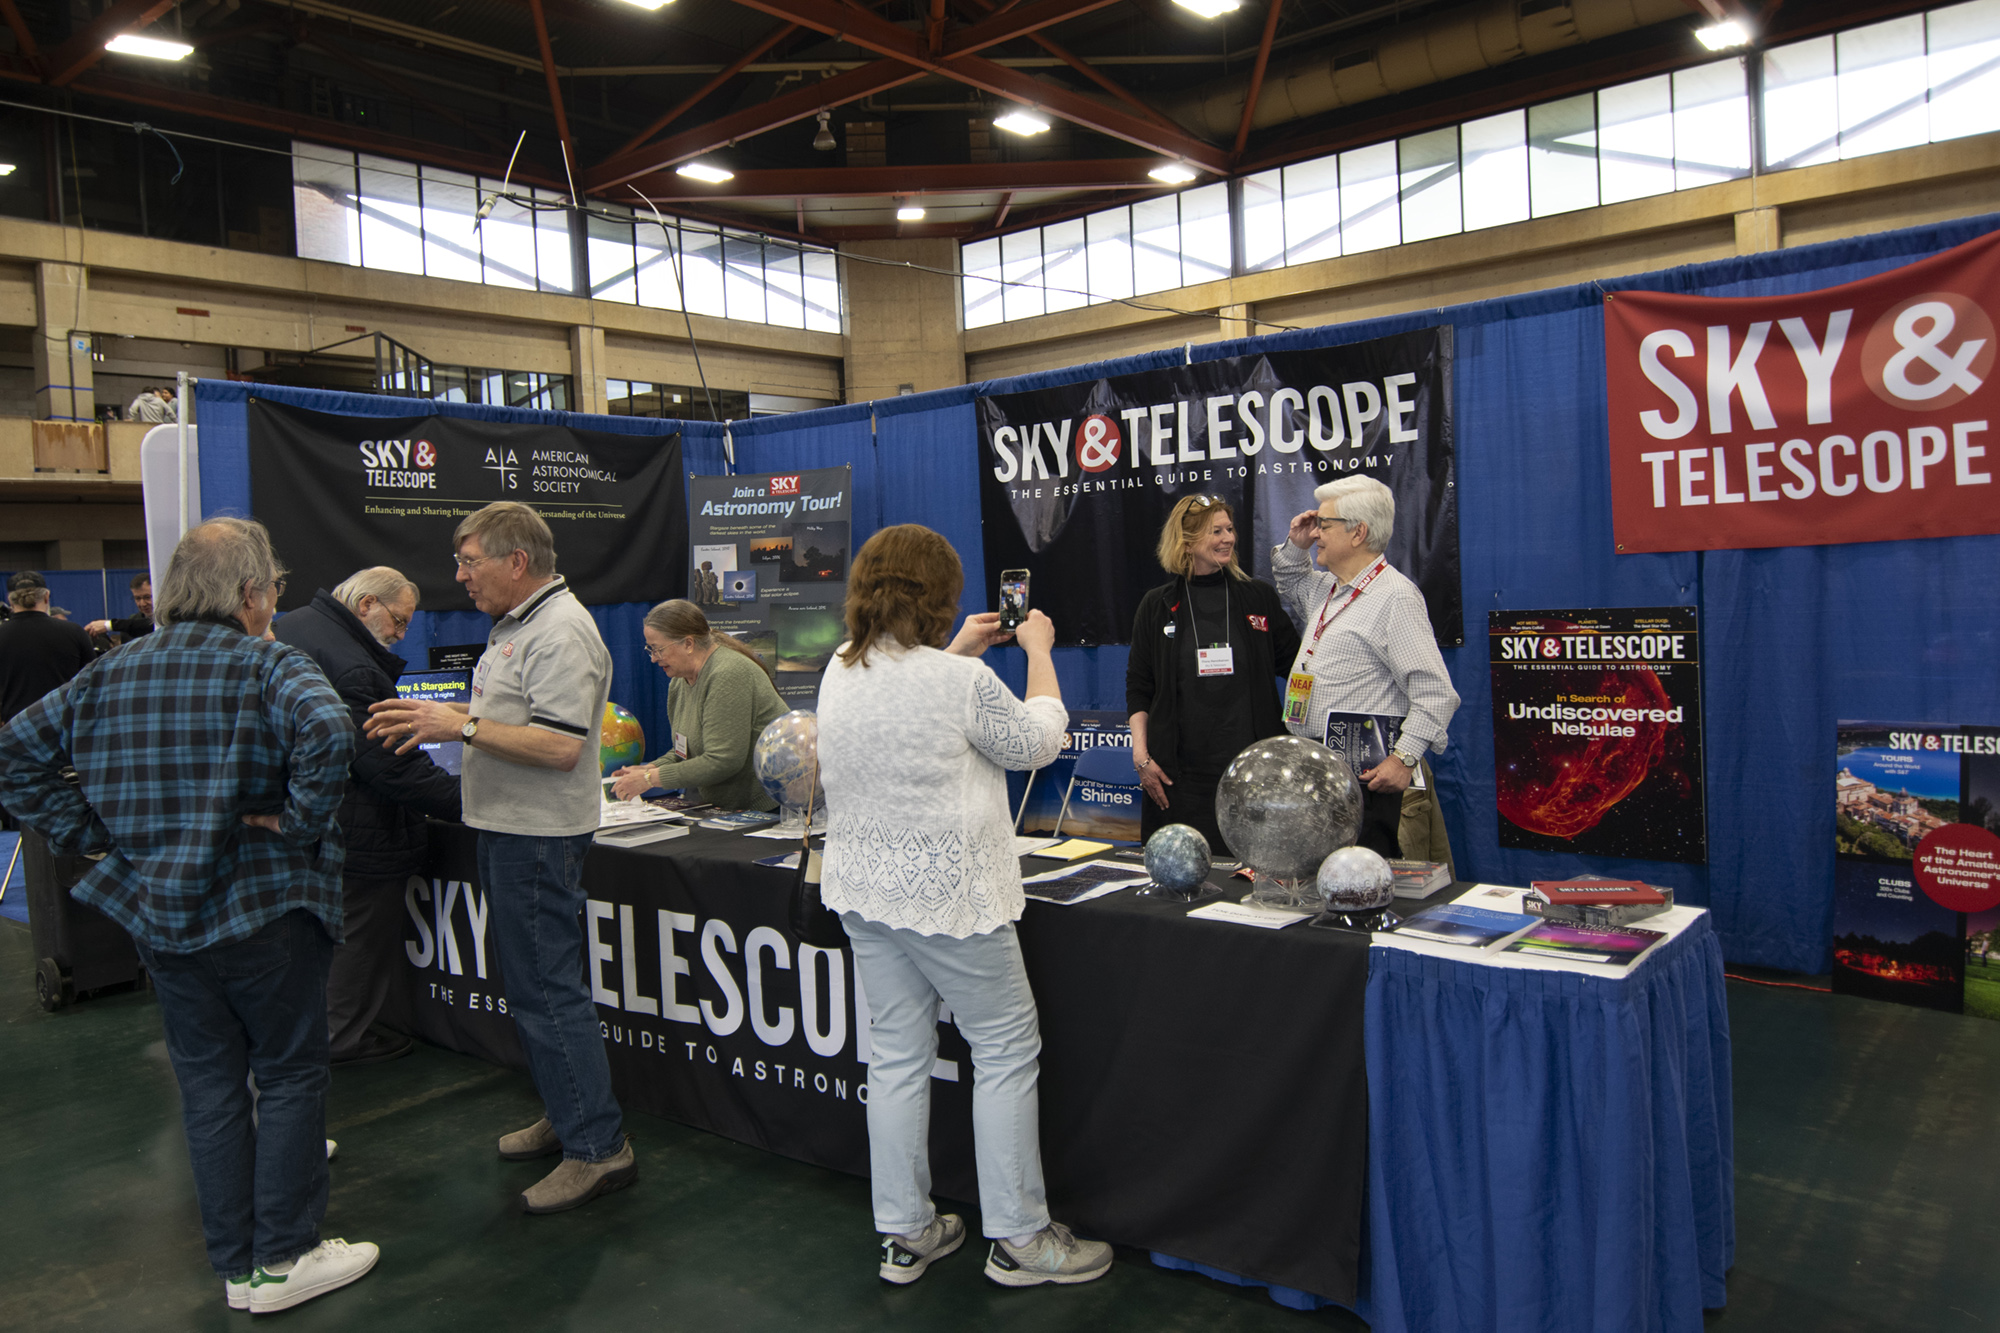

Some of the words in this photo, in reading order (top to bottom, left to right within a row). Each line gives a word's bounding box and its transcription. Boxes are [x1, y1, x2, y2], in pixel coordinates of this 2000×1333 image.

[1639, 308, 1854, 440] SKY
[1882, 301, 1988, 401] &
[993, 418, 1072, 484] SKY
[1080, 417, 1118, 469] &
[1120, 371, 1420, 468] TELESCOPE
[359, 439, 411, 469] SKY
[415, 441, 435, 467] &
[531, 450, 589, 464] AMERICAN
[1640, 420, 1991, 509] TELESCOPE
[365, 469, 437, 489] TELESCOPE
[532, 465, 617, 482] ASTRONOMICAL
[1010, 488, 1043, 500] THE
[1053, 476, 1144, 497] ESSENTIAL
[1155, 469, 1213, 486] GUIDE
[1226, 466, 1247, 479] TO
[1258, 454, 1395, 476] ASTRONOMY
[533, 480, 580, 493] SOCIETY
[732, 487, 755, 498] Join
[757, 488, 765, 497] a
[770, 476, 798, 491] SKY
[365, 505, 405, 517] Enhancing
[407, 506, 421, 516] and
[423, 507, 451, 518] Sharing
[452, 509, 476, 517] Huma
[537, 510, 576, 520] derstanding
[577, 510, 586, 519] of
[586, 511, 597, 519] the
[598, 511, 625, 519] Universe
[701, 500, 796, 518] Astronomy
[800, 491, 843, 511] Tour!
[1501, 636, 1541, 659] SKY
[1543, 638, 1561, 658] &
[1561, 635, 1685, 660] TELESCOPE
[413, 683, 420, 692] &
[421, 680, 465, 692] Stargazing
[1557, 694, 1567, 703] In
[1569, 694, 1611, 703] Search
[1613, 694, 1626, 704] of
[1508, 702, 1683, 723] Undiscovered
[1552, 721, 1636, 737] Nebulae
[1328, 721, 1347, 761] 024
[1889, 732, 1923, 750] SKY
[1924, 735, 1940, 750] &
[1880, 755, 1914, 763] TOURS
[1081, 788, 1133, 805] Shines
[1934, 846, 1956, 856] The
[1959, 849, 1993, 859] Heart
[1920, 855, 1932, 863] of
[1935, 857, 1954, 865] the
[1956, 859, 2000, 870] Amateu
[1878, 878, 1912, 888] CLUBS
[1937, 876, 1989, 889] Universe
[1526, 900, 1543, 909] SKY
[1888, 893, 1914, 902] Counting
[429, 983, 455, 1005] THE
[600, 1020, 666, 1054] GUIDE
[685, 1041, 718, 1064] TO
[732, 1056, 868, 1105] ASTRONO
